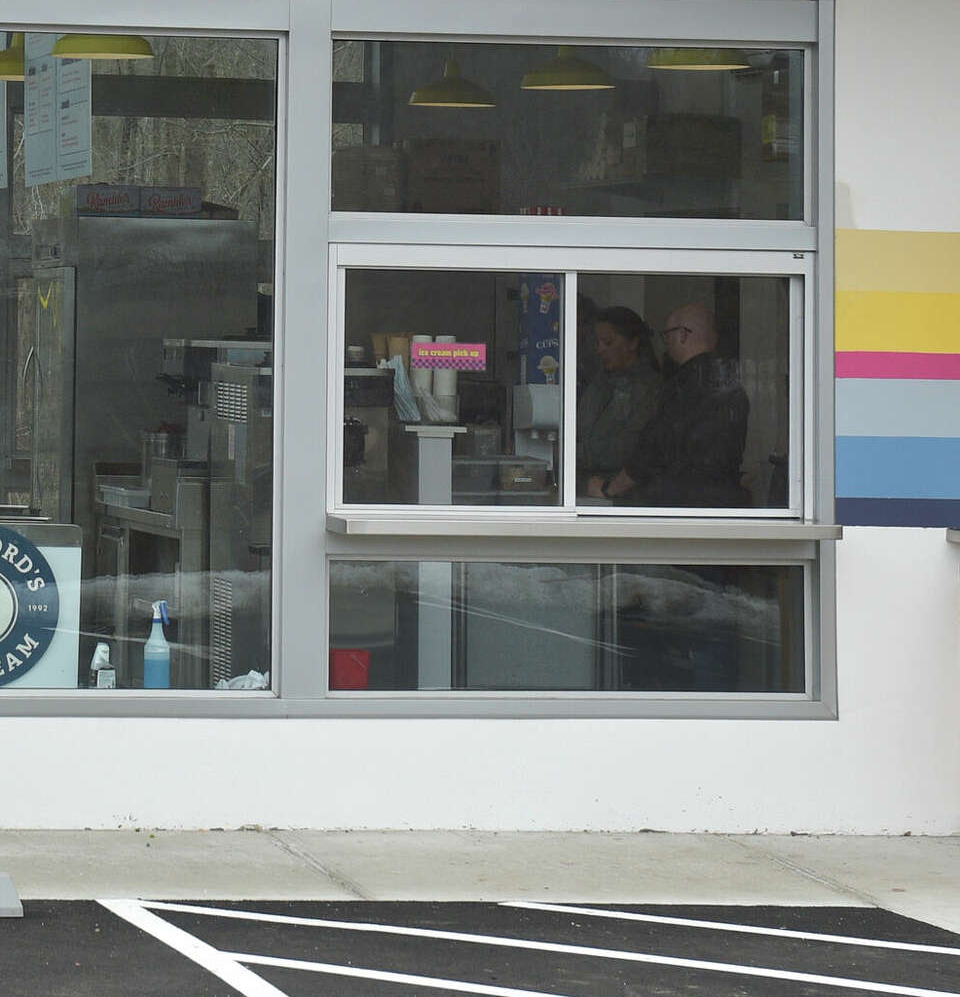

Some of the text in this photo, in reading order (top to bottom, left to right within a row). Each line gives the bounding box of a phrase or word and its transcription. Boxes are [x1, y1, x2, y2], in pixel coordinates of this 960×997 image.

[418, 348, 479, 359] ice cream pick up
[28, 604, 48, 612] 1992
